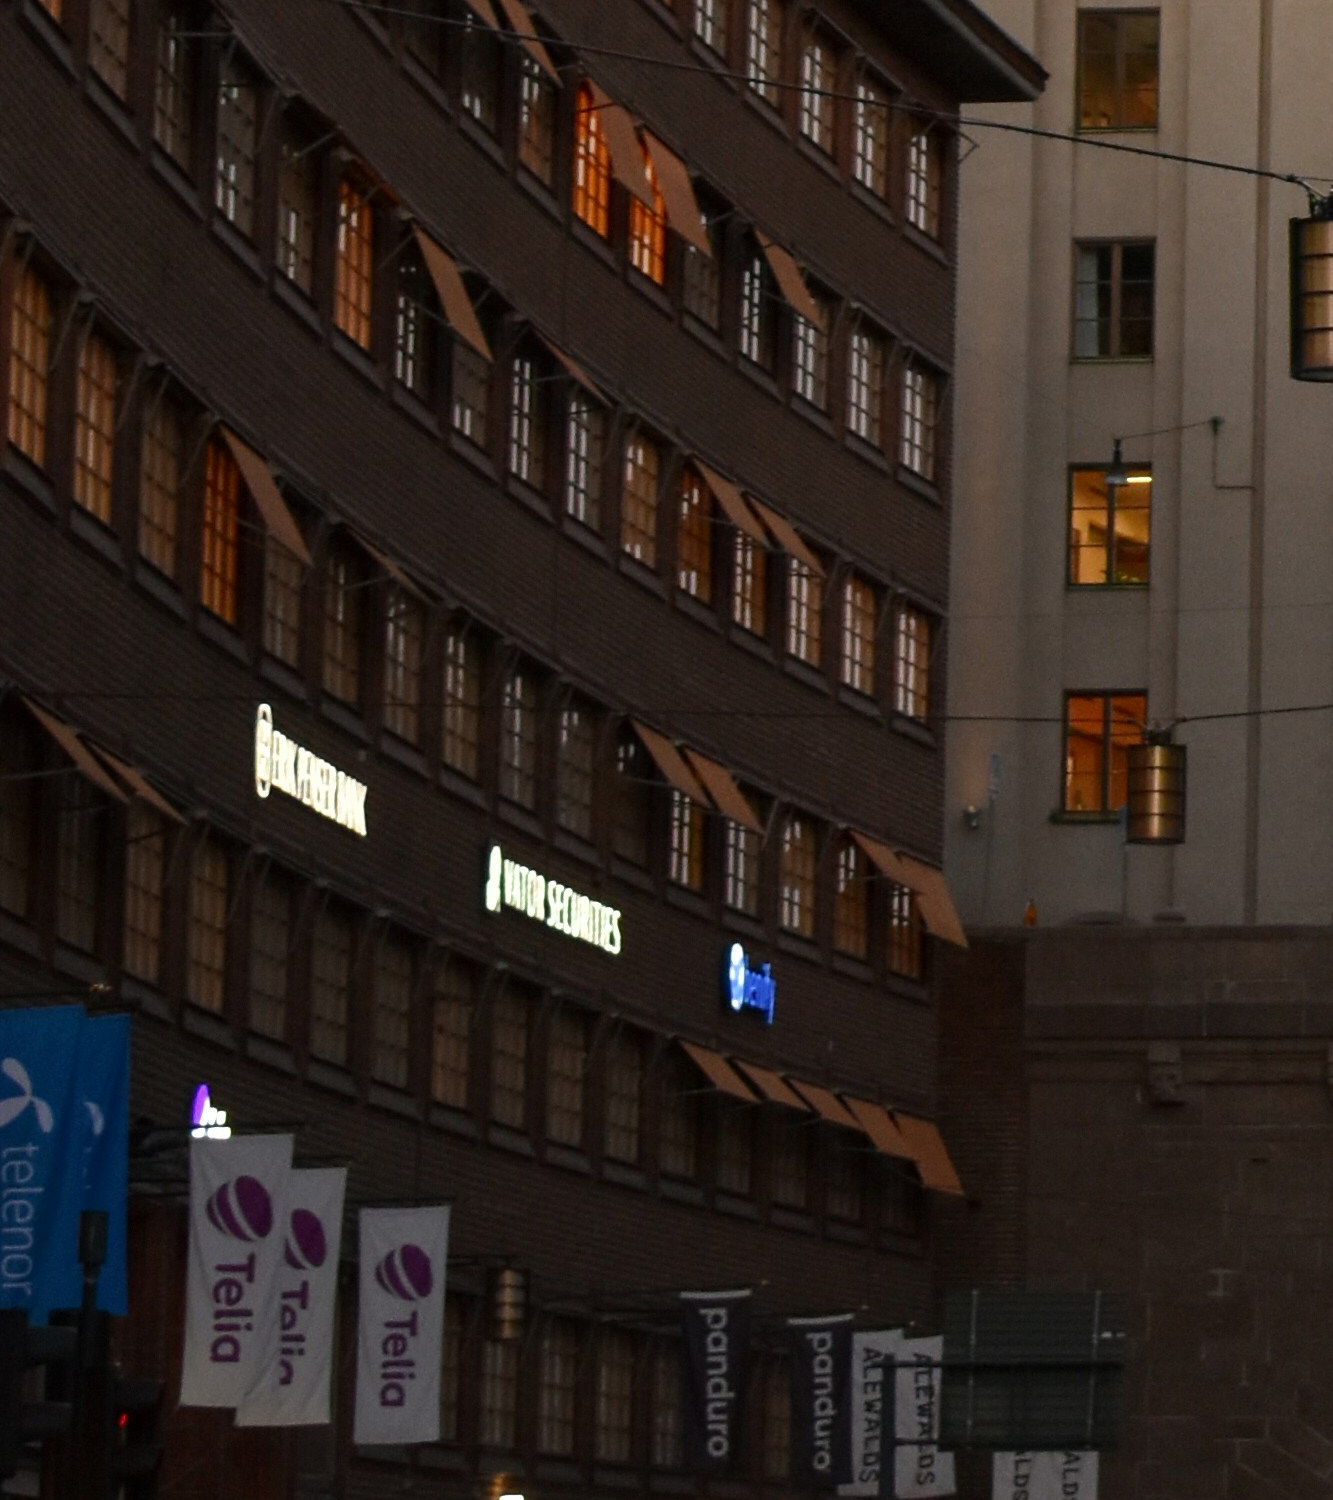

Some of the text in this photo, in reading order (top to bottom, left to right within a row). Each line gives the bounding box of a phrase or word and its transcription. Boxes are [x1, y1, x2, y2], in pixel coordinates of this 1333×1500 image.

[1, 1142, 45, 1297] telenor
[210, 1252, 256, 1363] Telia
[380, 1310, 418, 1407] Telia
[698, 1306, 736, 1458] panduro
[805, 1331, 838, 1471] panduro
